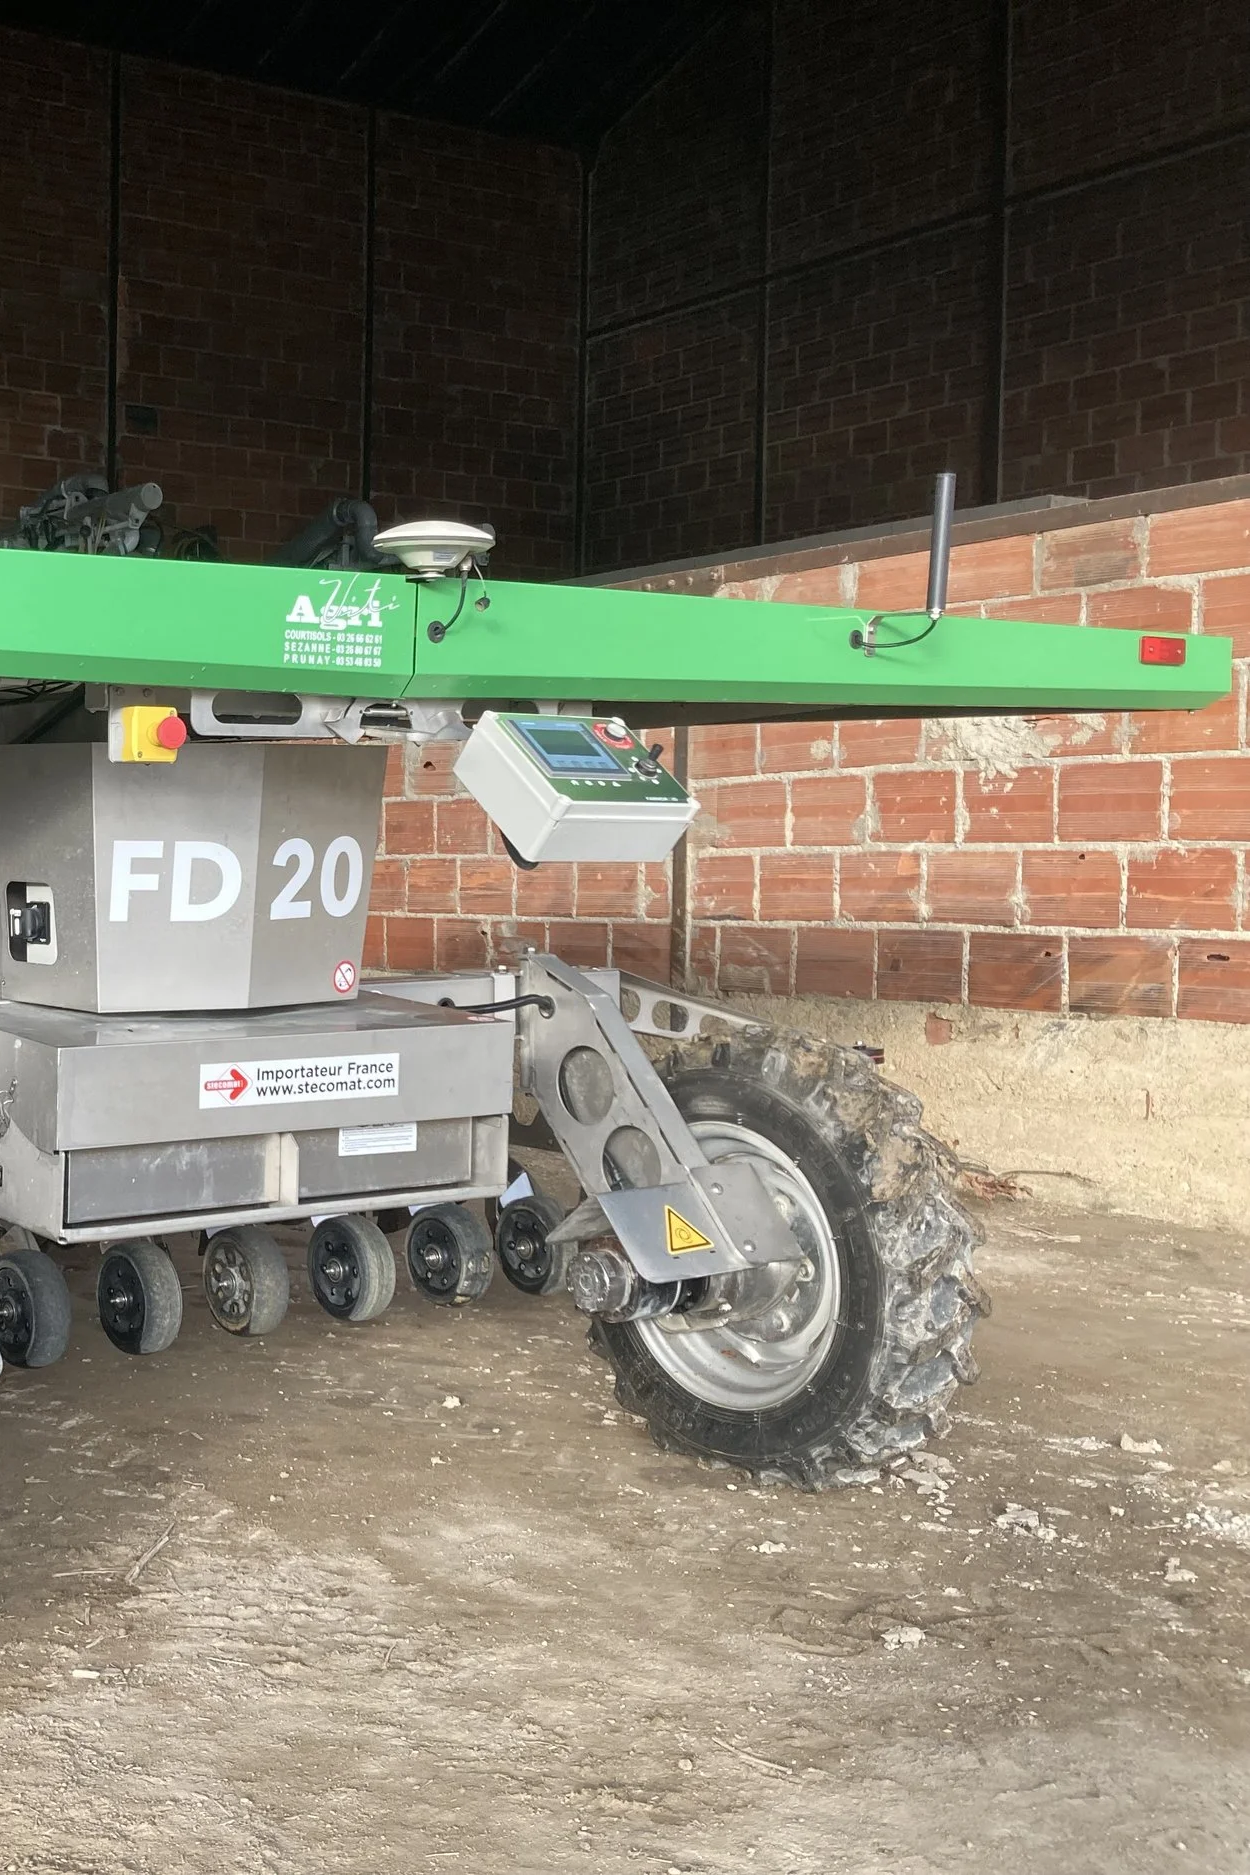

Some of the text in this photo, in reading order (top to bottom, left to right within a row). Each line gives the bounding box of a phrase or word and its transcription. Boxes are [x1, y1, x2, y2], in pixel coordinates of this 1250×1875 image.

[286, 595, 382, 630] Agri
[284, 629, 331, 642] COURTISOLS
[337, 632, 345, 642] 03
[284, 641, 331, 654] SEZANNE
[283, 653, 331, 665] PRUNAY
[109, 835, 364, 922] FD 20
[256, 1061, 394, 1082] Importateur France
[256, 1077, 396, 1097] www.stecomat.com
